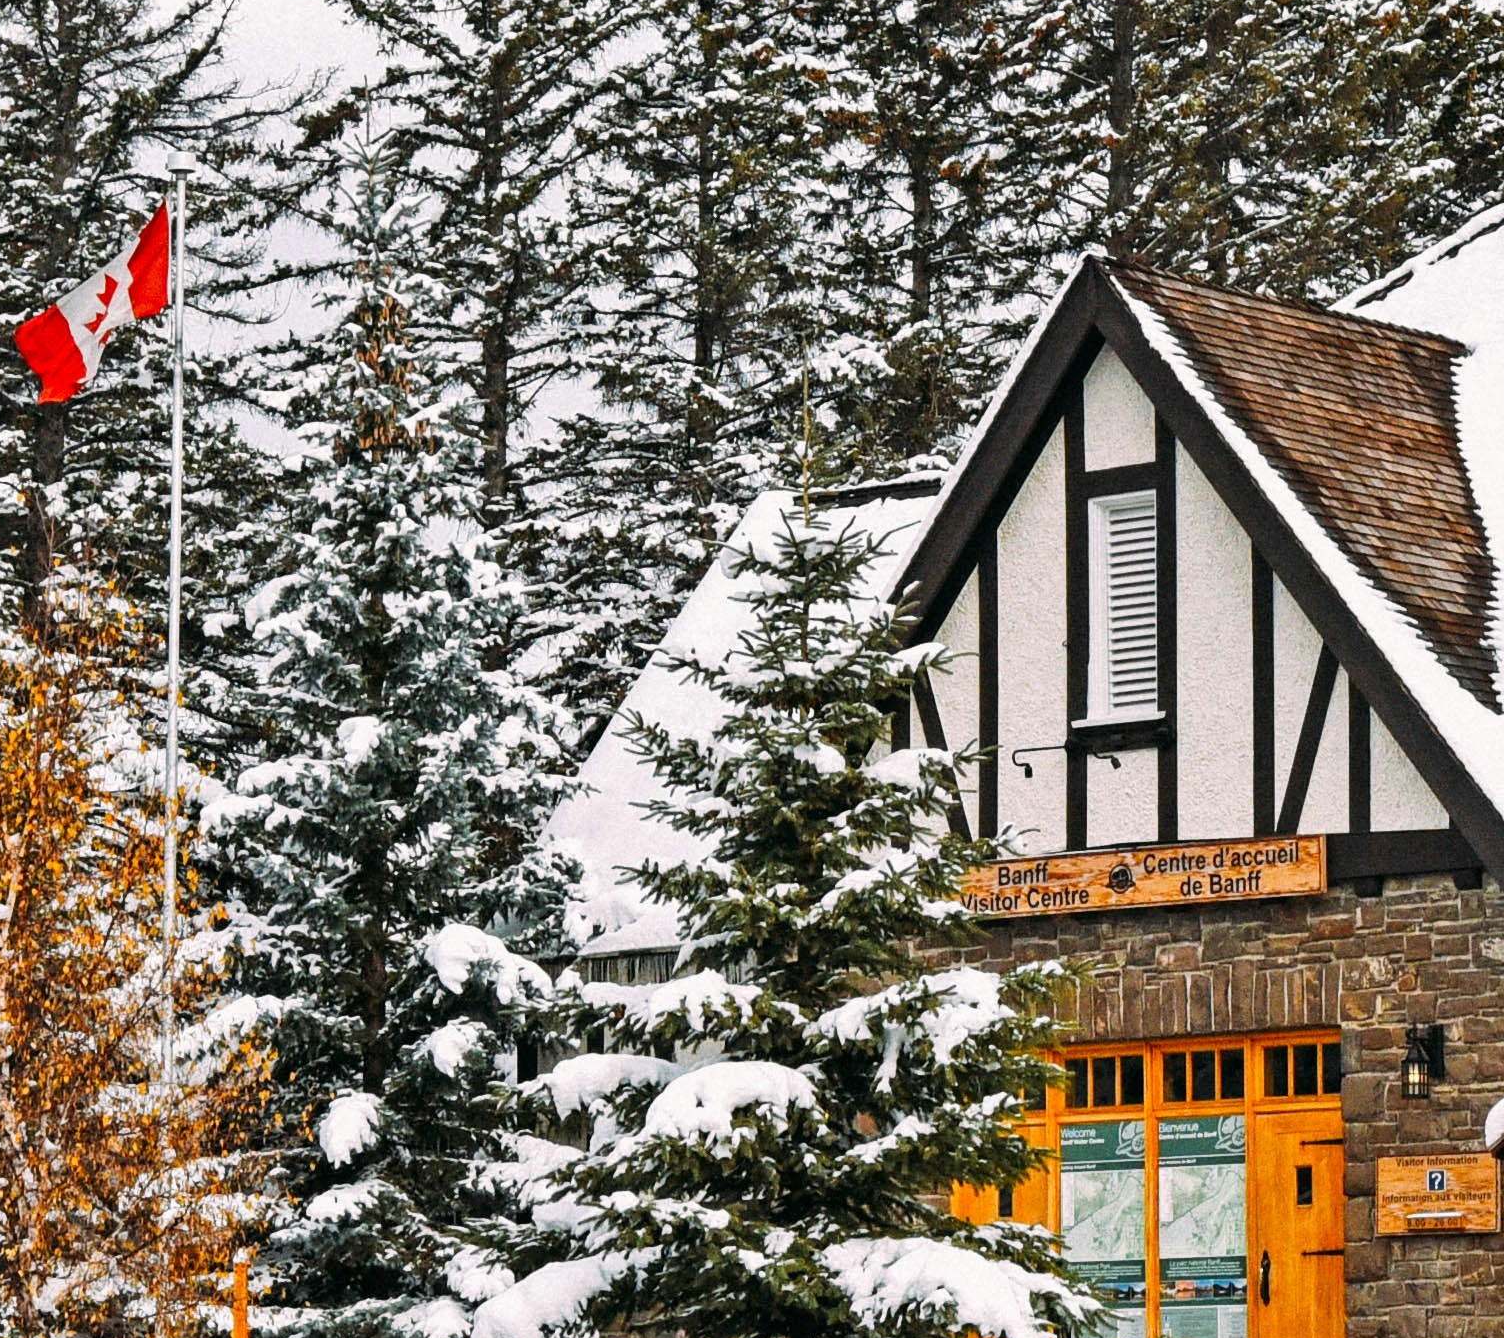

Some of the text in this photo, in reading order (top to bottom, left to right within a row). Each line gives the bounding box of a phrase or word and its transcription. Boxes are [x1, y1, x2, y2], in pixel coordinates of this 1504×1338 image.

[1143, 841, 1299, 874] Centre d'accueil
[998, 862, 1049, 886] Banff
[1180, 871, 1262, 897] de Banff
[960, 887, 1089, 912] Visitor Centre
[1396, 1155, 1479, 1167] Visitor Information
[1382, 1193, 1432, 1204] Information
